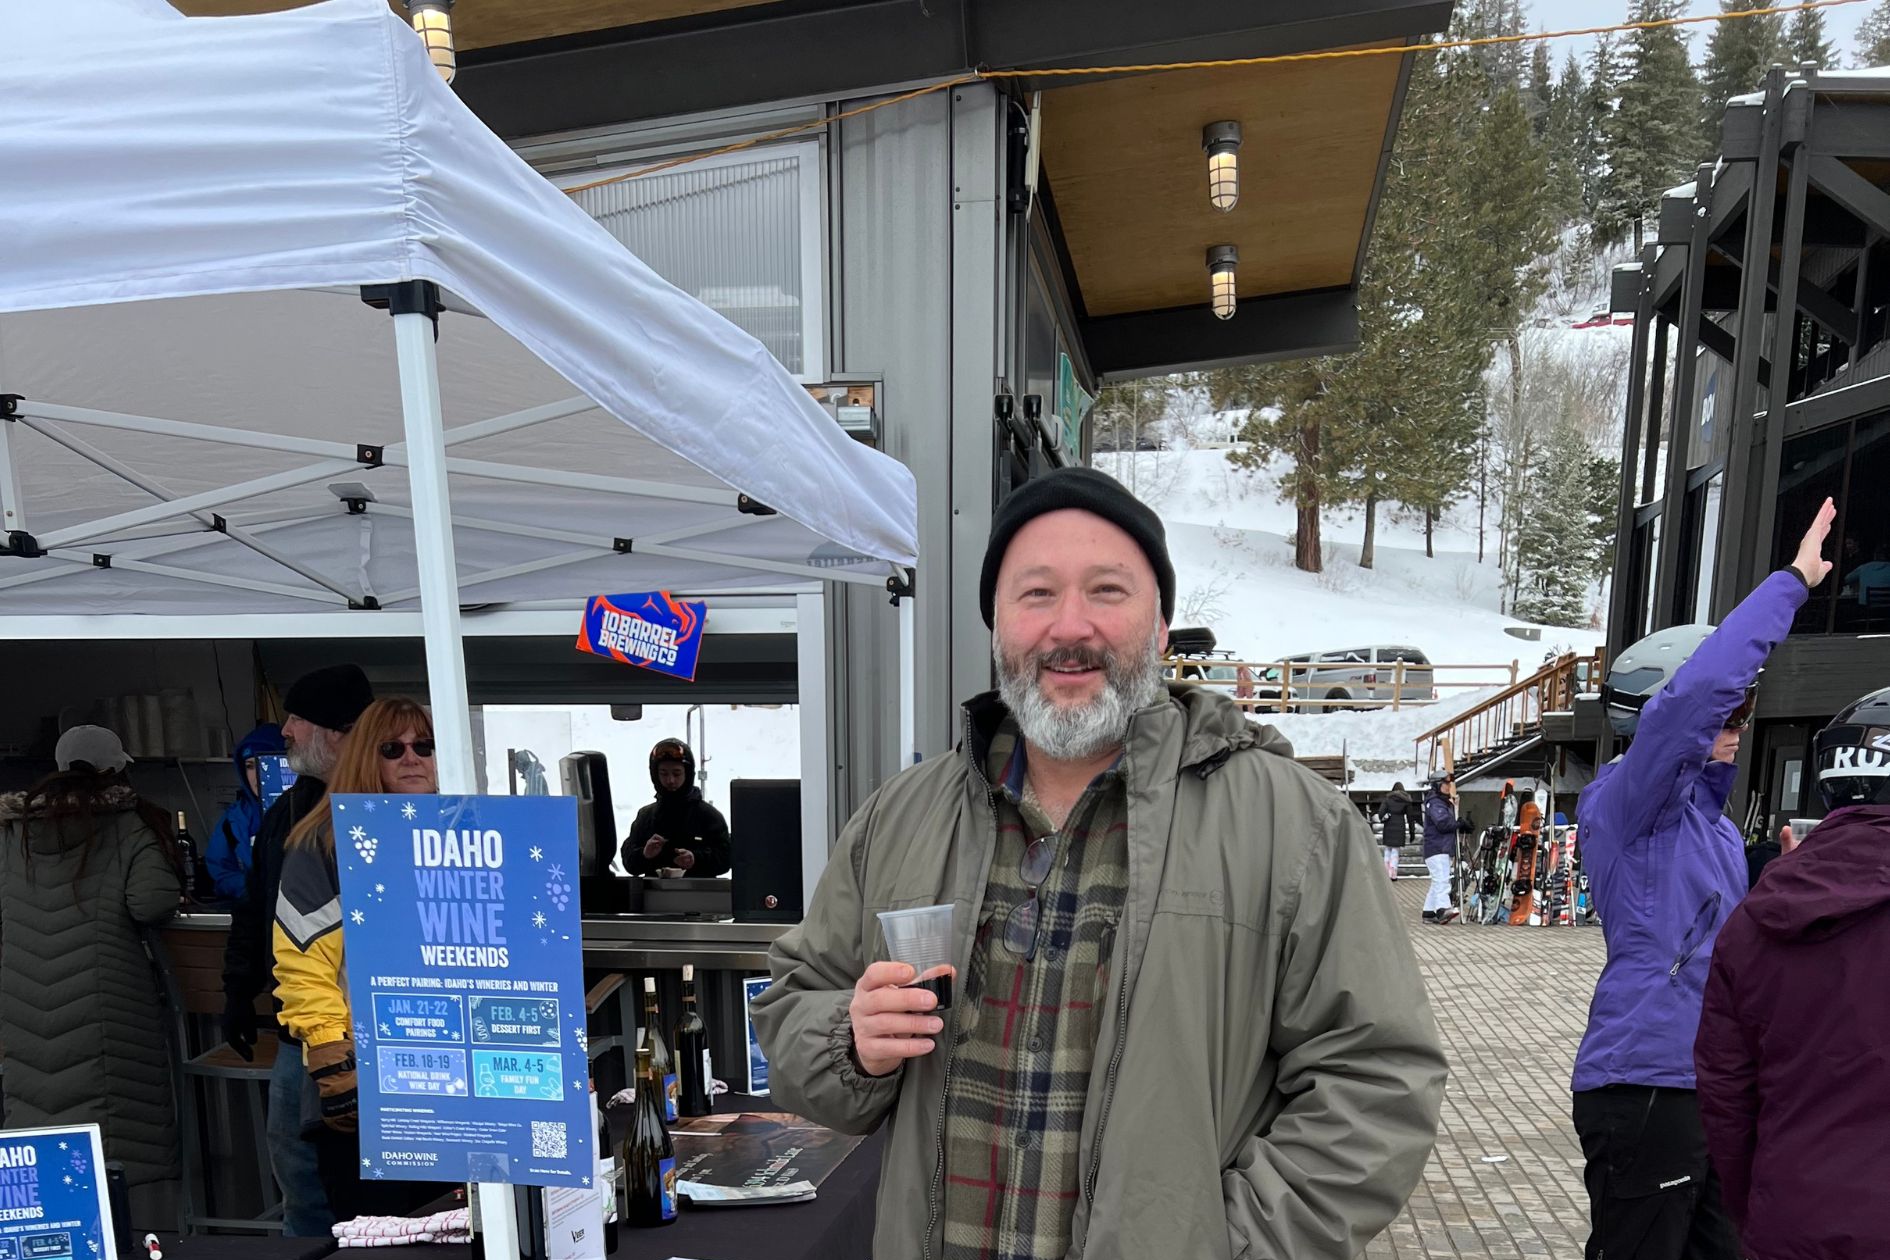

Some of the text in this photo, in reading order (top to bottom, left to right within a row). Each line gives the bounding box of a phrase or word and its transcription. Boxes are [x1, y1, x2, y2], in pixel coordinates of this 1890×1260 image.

[602, 610, 679, 651] 10 BARREL
[598, 628, 658, 662] BREWING
[412, 829, 503, 868] IDAHO
[414, 869, 505, 900] WINTER
[417, 901, 507, 945] WINE
[420, 944, 510, 968] WEEKENDS
[370, 976, 559, 993] A PERFECT PAIRING: IDAHO'S WINERIES AND WINTER
[388, 1000, 448, 1016] JAN. 21-22
[491, 1006, 539, 1022] FEB. 4-5
[395, 1017, 445, 1028] COMFORT FOOD
[491, 1024, 541, 1035] DESSERT FIRST
[405, 1028, 437, 1038] PAIRINGS
[395, 1053, 450, 1069] FEB. 18-19
[493, 1057, 544, 1073] MAR. 4-5
[397, 1071, 429, 1080] NATIONAL
[500, 1075, 540, 1085] FAMILY FUN
[408, 1081, 441, 1091] WINE DAY
[0, 1145, 37, 1168] AHO
[0, 1167, 39, 1184] NTER
[0, 1206, 44, 1221] EEKENDS
